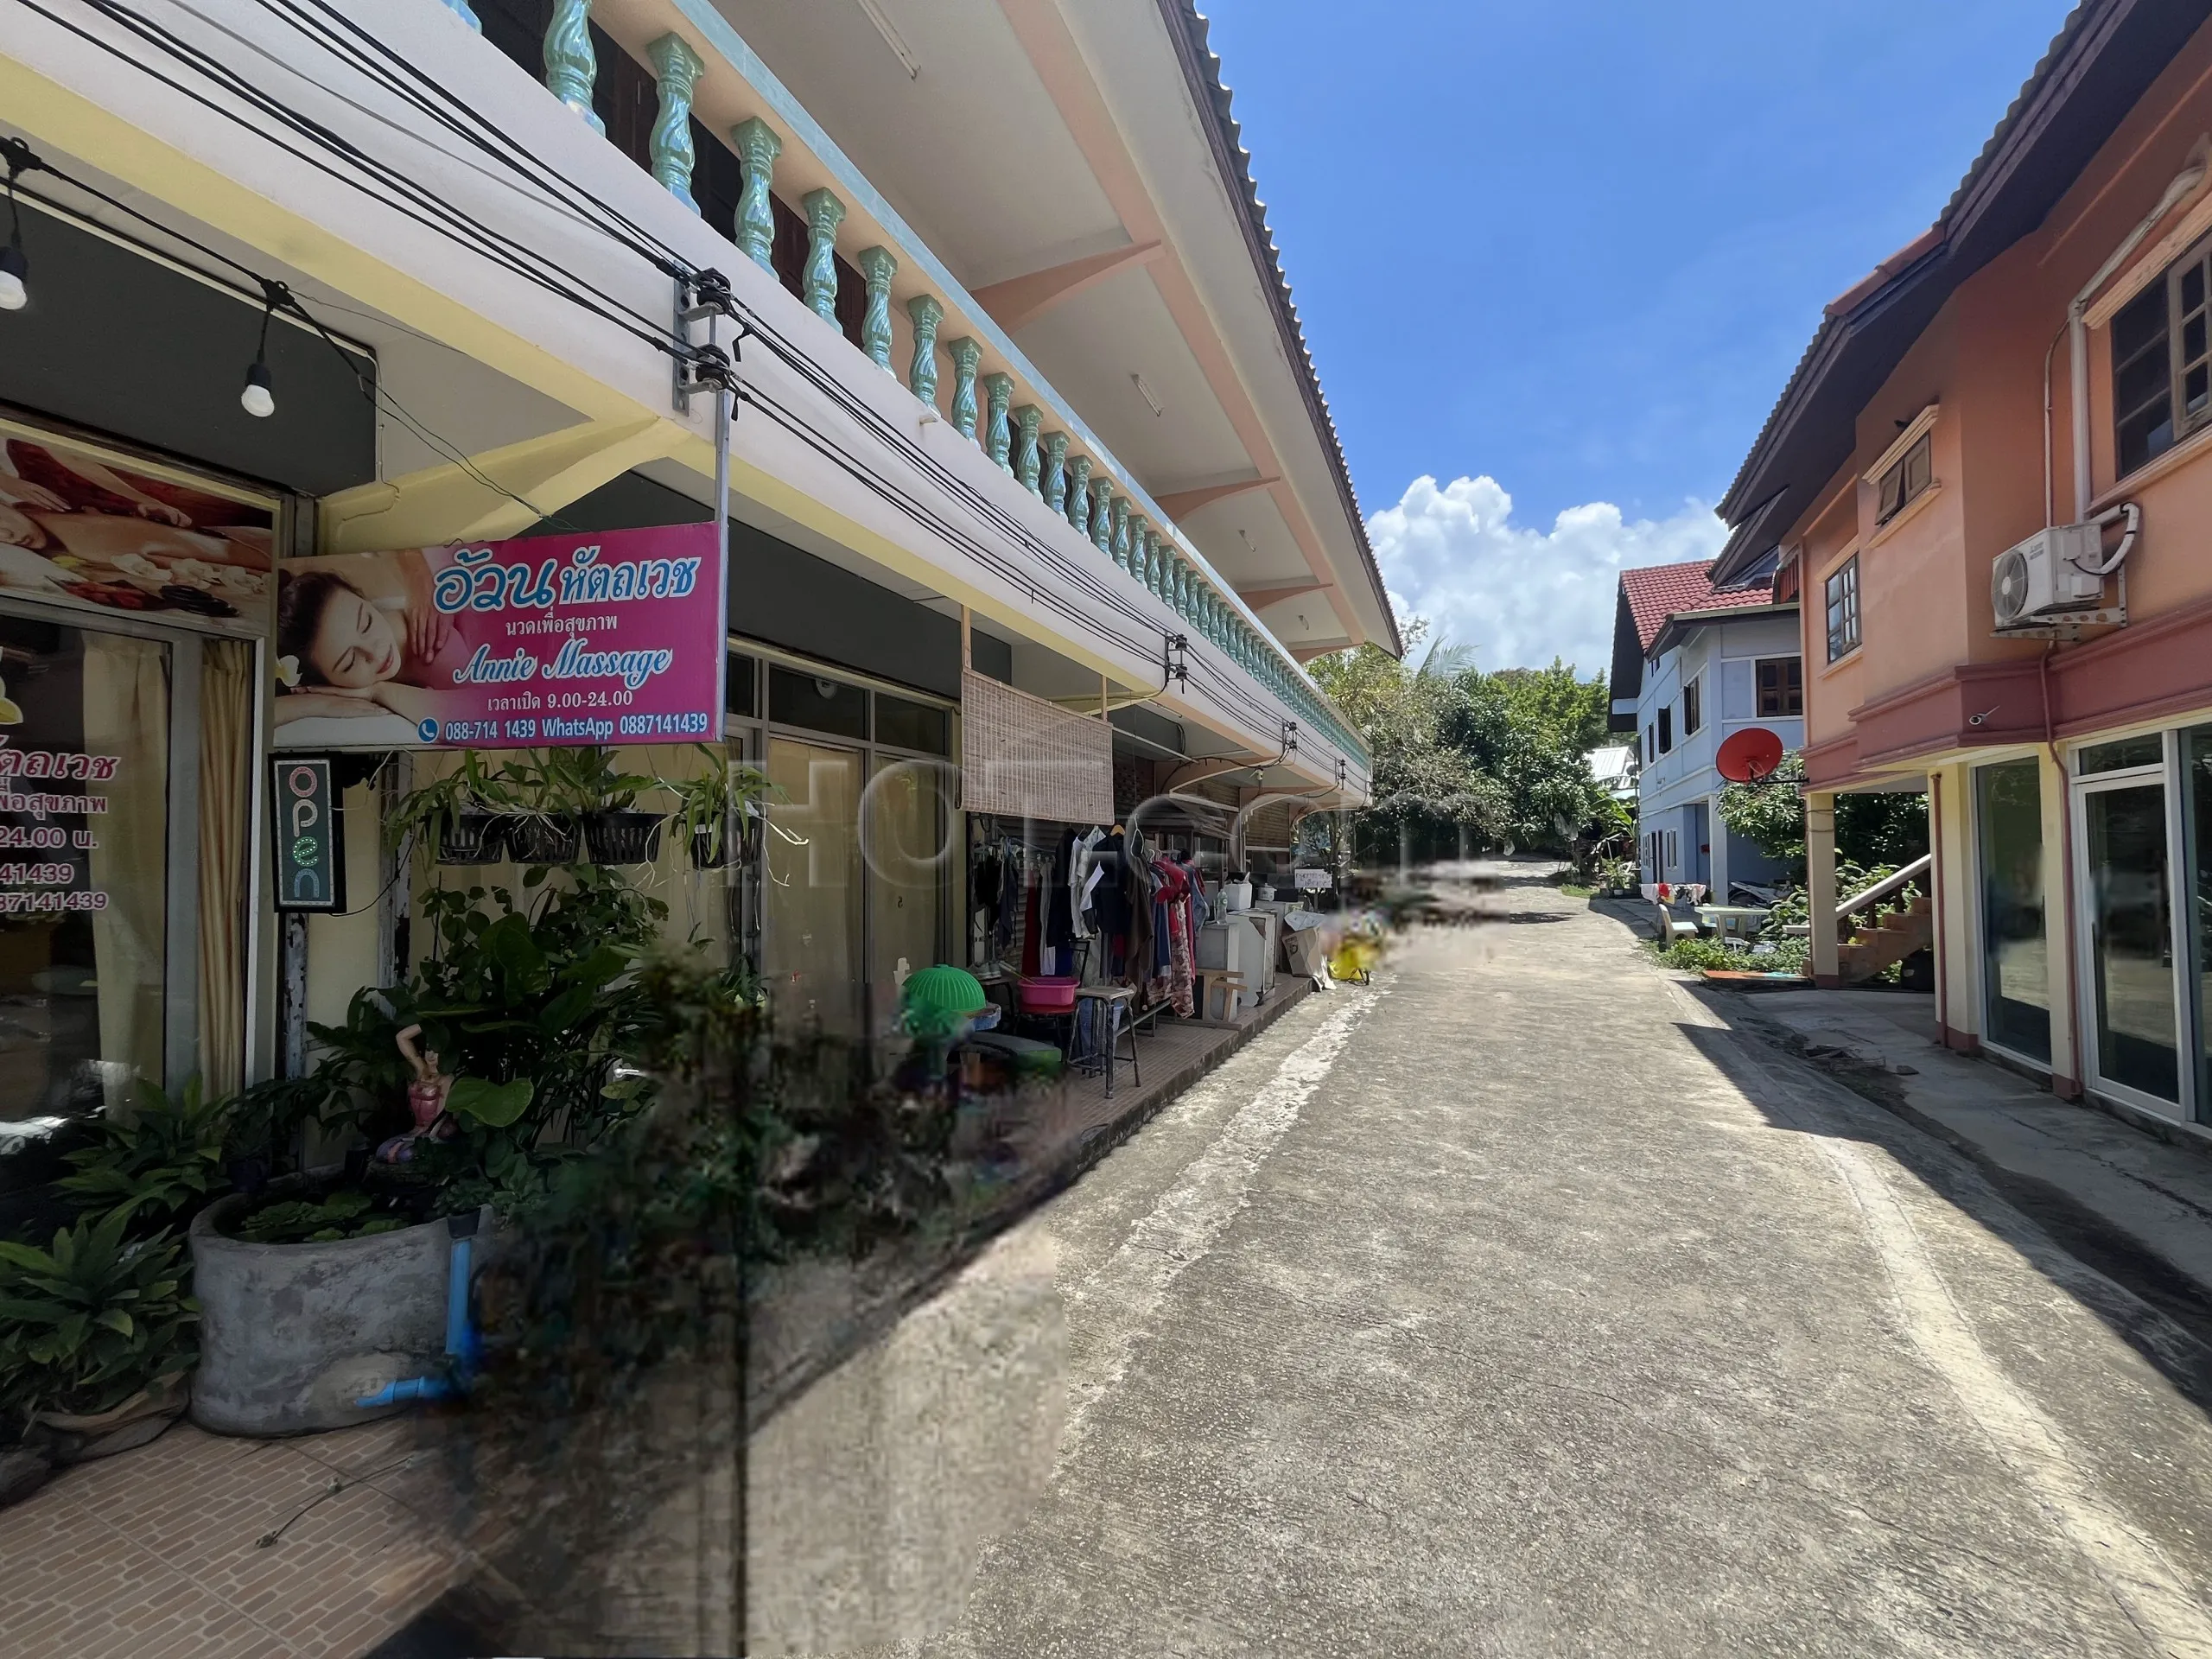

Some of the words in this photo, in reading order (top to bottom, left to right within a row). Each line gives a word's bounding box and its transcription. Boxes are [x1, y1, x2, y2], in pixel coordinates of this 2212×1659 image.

[434, 548, 557, 614] อ้วน
[559, 545, 702, 605] หัตถเวช
[505, 606, 618, 639] นวดเพื่อสุขภาพ
[453, 643, 537, 683] Annie
[542, 638, 673, 690] Massage
[487, 691, 540, 711] เวลาเปิด
[547, 690, 632, 709] 9.00-24.00
[445, 721, 499, 741] 088-714
[505, 719, 536, 739] 1439
[542, 716, 613, 741] WhatsApp
[620, 713, 708, 734] 0887141439
